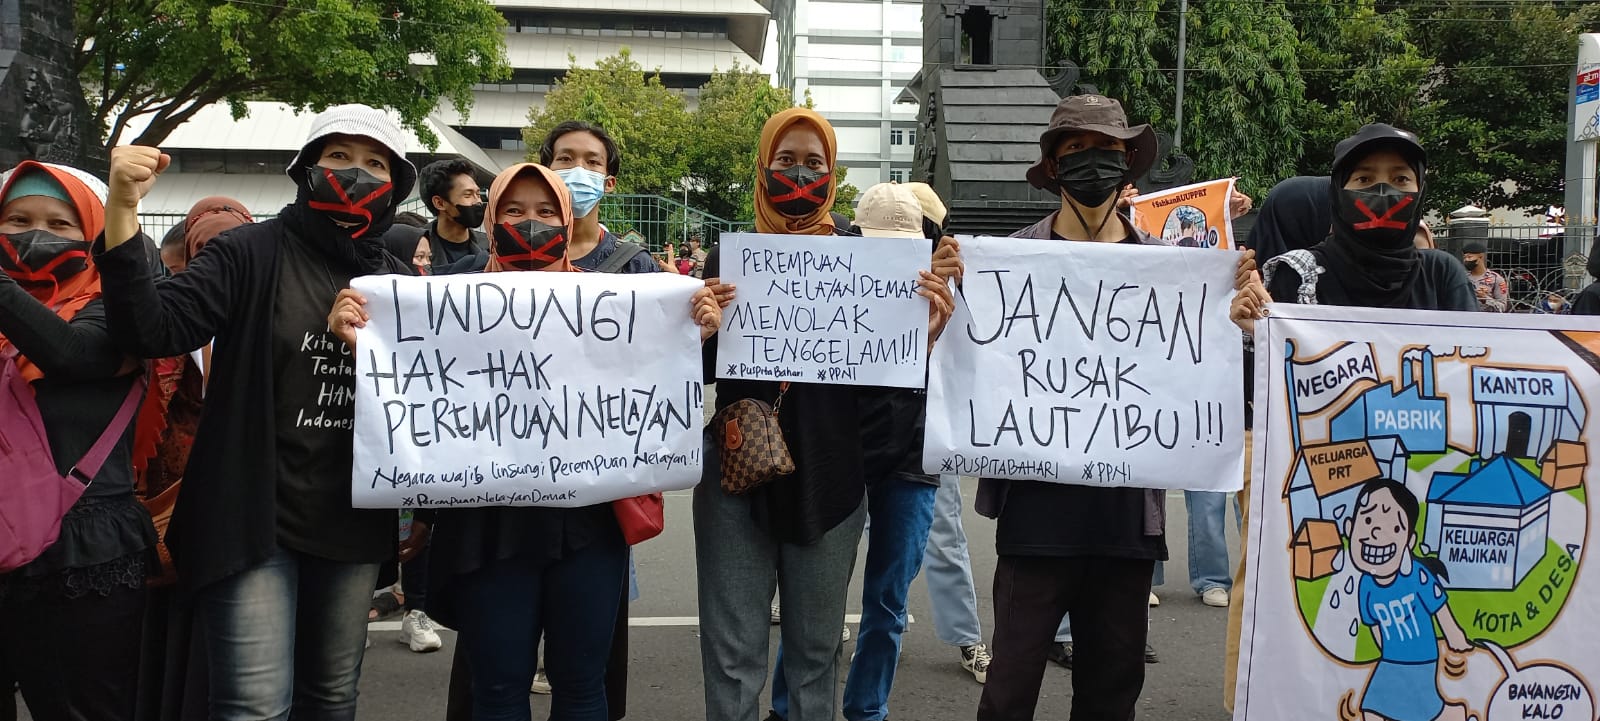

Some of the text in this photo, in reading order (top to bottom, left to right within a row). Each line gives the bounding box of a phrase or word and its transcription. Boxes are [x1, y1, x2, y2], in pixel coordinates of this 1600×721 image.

[742, 248, 852, 277] PEREMPUAN
[767, 273, 921, 303] NELAYAN DEMAK
[393, 279, 636, 343] LINDUNGI
[727, 302, 874, 334] MENOLAK
[967, 270, 1207, 365] JANGAN
[301, 331, 334, 352] Kita
[742, 328, 919, 366] TENGGELAM!!!
[312, 356, 356, 377] Tenta
[366, 348, 552, 396] HAK-HAK
[817, 366, 856, 381] #PPNI
[1018, 349, 1151, 400] RUSAK
[1297, 354, 1374, 398] NEGARA
[1480, 376, 1555, 396] KANTOR
[296, 408, 354, 430] Indones
[384, 385, 567, 454] PEREMPUAN
[1374, 409, 1443, 430] PABRIK
[940, 454, 1131, 483] #PUSPITABAHARI #PPNI
[1310, 446, 1368, 466] KELUARGA
[371, 466, 435, 489] Negara
[441, 465, 484, 487] wajib
[1328, 465, 1352, 480] PRT
[1444, 529, 1515, 548] KELUARGA
[1448, 547, 1508, 565] MAJIKAN
[1472, 541, 1580, 634] KOTA & DESA
[1374, 593, 1417, 643] PRT
[1508, 682, 1581, 701] BAYANGIN
[1522, 703, 1563, 720] KALO
